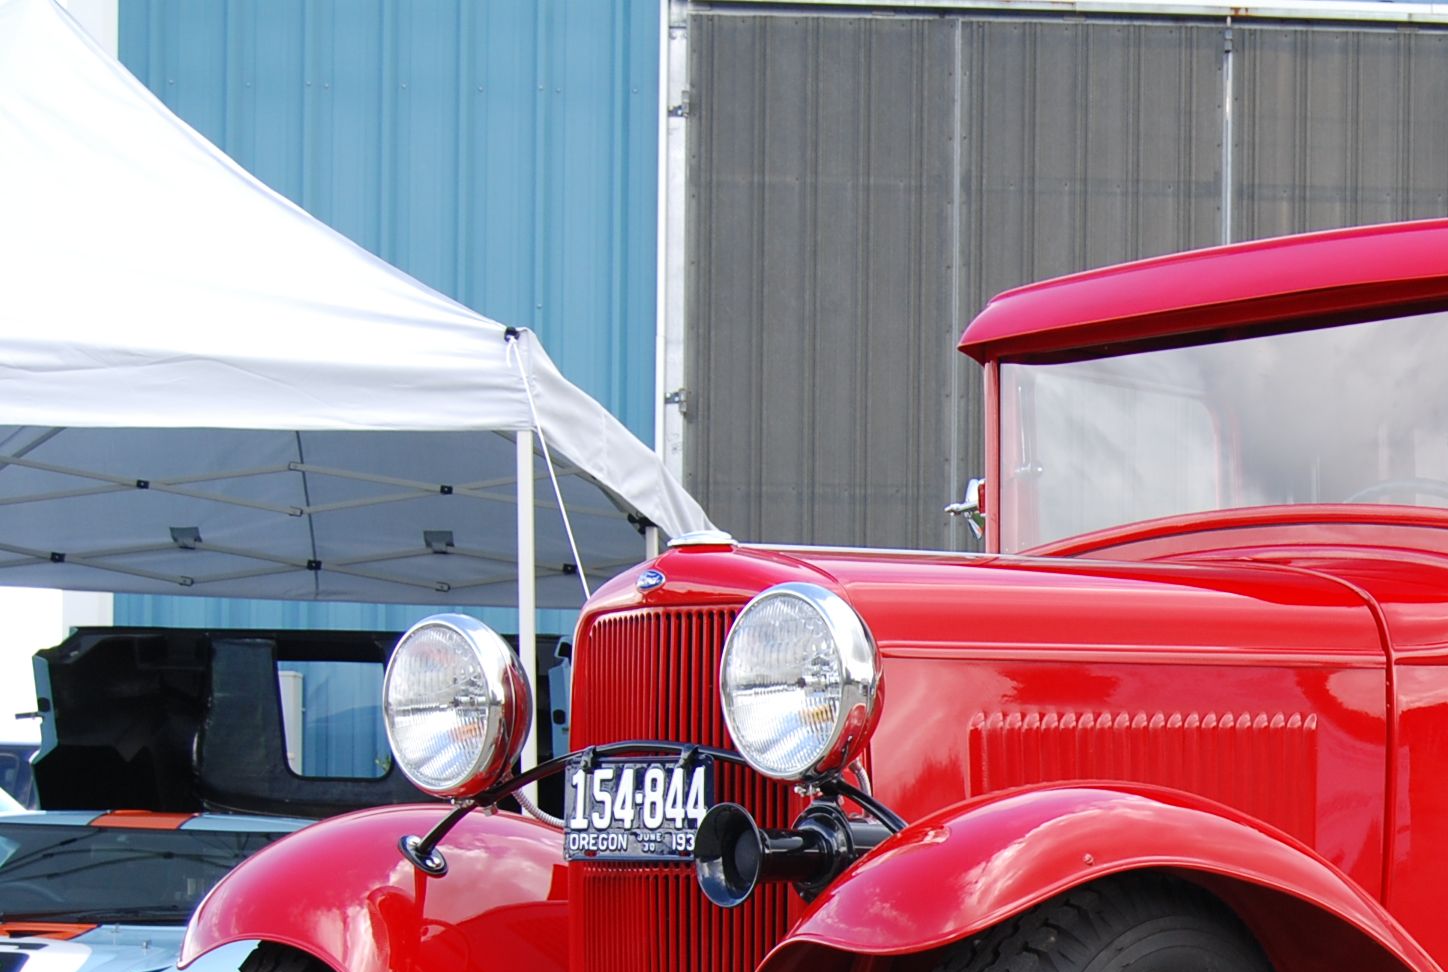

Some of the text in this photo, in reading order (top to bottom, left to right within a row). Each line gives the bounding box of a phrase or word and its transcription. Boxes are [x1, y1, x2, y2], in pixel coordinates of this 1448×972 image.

[570, 766, 706, 829] 154-844
[569, 832, 695, 851] OREGON JUNE 193
